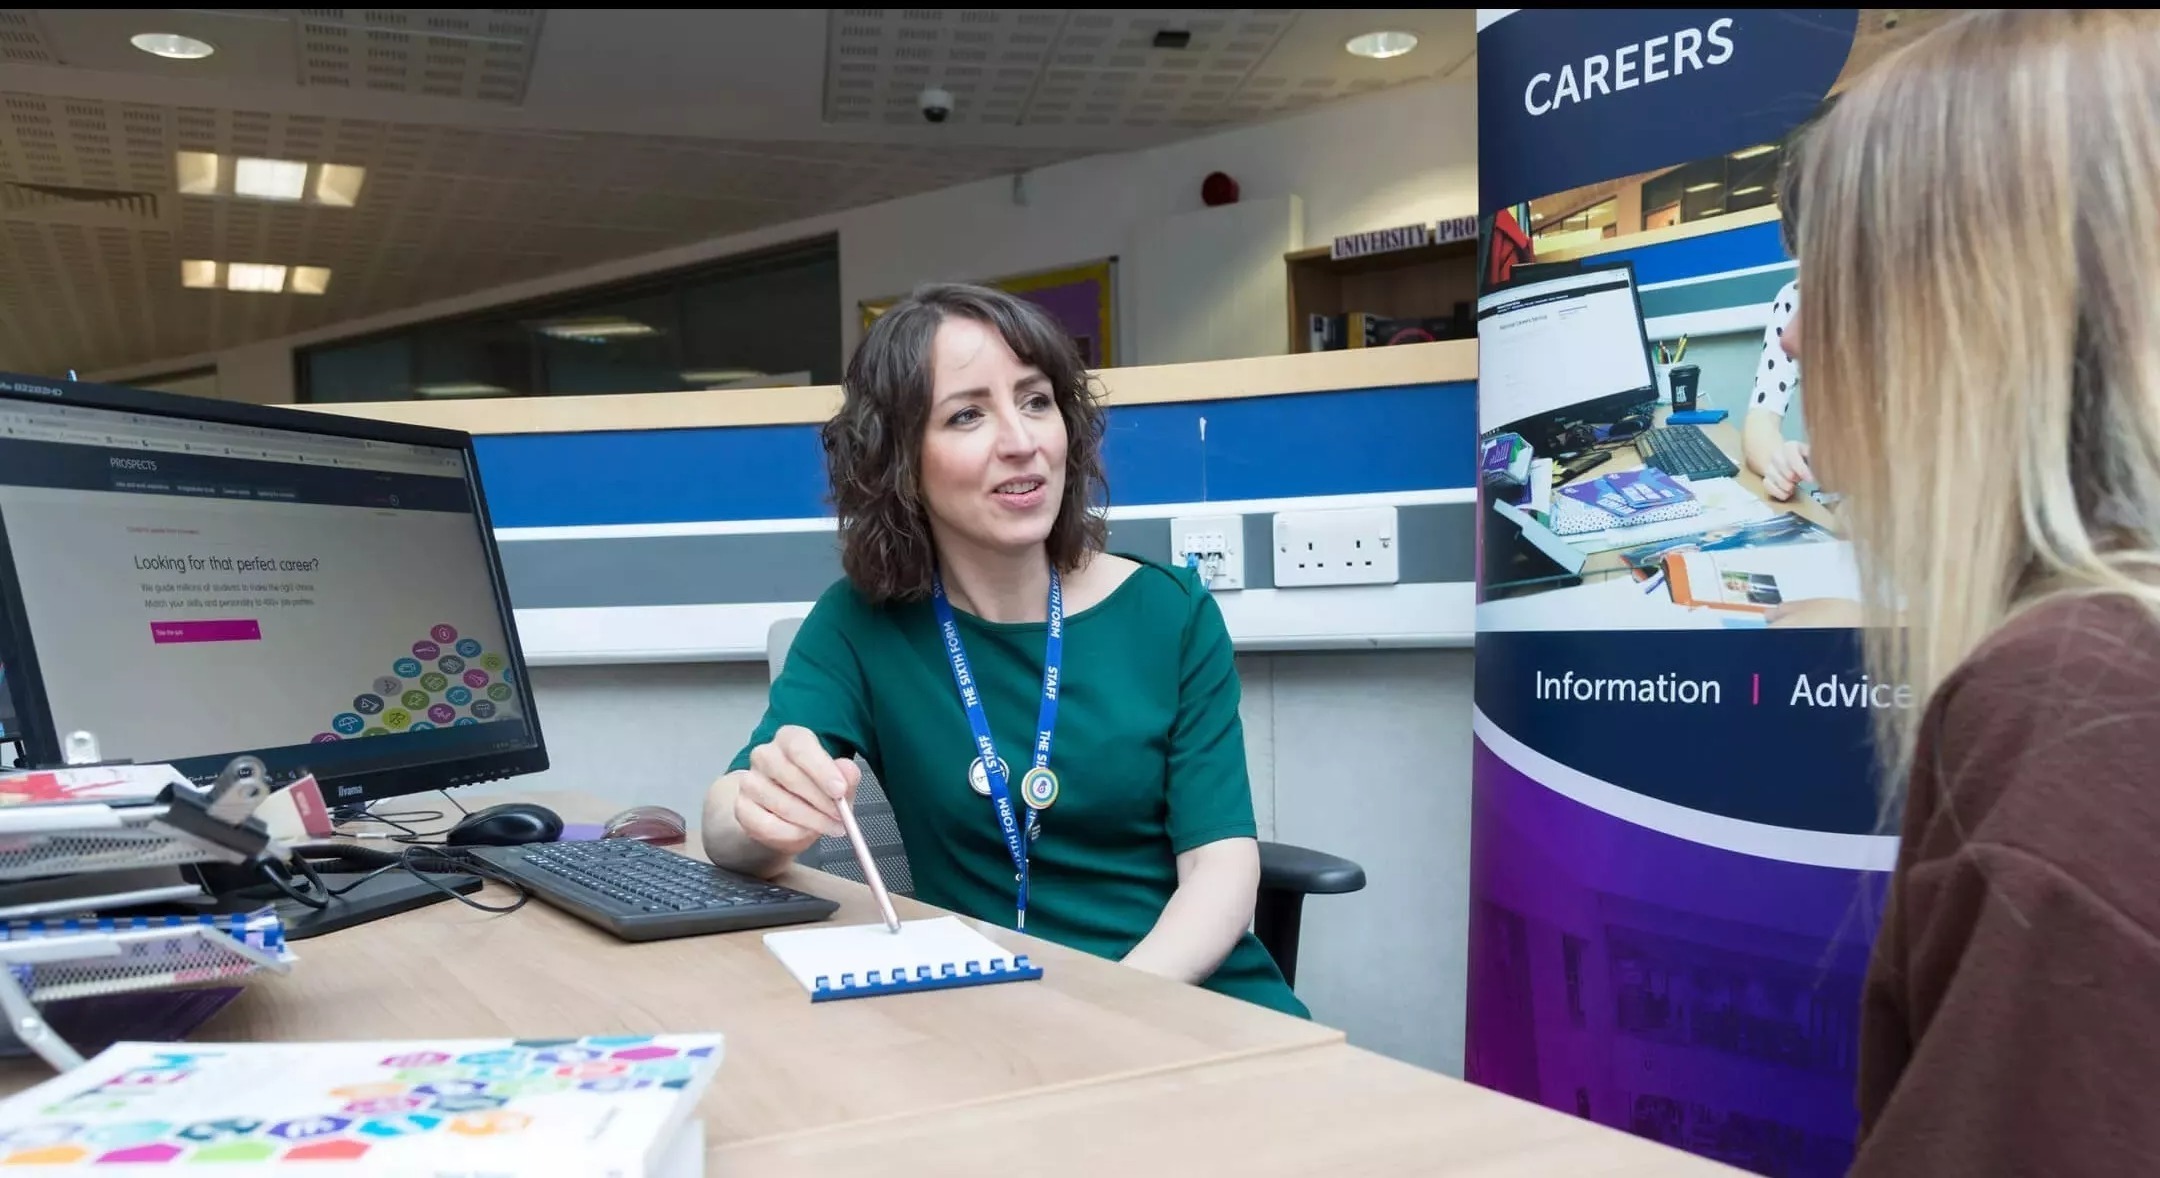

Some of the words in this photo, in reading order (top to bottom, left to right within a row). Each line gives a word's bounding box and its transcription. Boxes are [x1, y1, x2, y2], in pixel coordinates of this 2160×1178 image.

[1524, 18, 1735, 116] CAREERS
[1333, 223, 1427, 256] UNIVERSITY
[110, 457, 157, 471] PROSPECTS
[134, 555, 187, 574] Looking
[188, 555, 206, 571] for
[209, 556, 234, 571] that
[237, 556, 276, 574] perfect
[279, 557, 319, 572] career?
[943, 620, 962, 653] FORM
[1050, 604, 1061, 638] FORM
[952, 653, 971, 686] SIXTH
[1046, 666, 1058, 701] STAFF
[962, 686, 978, 708] THE
[1536, 671, 1721, 706] Information
[1790, 674, 1914, 709] Advice
[978, 735, 997, 769] STAFF
[1038, 730, 1051, 752] THE
[997, 797, 1016, 833] FORM
